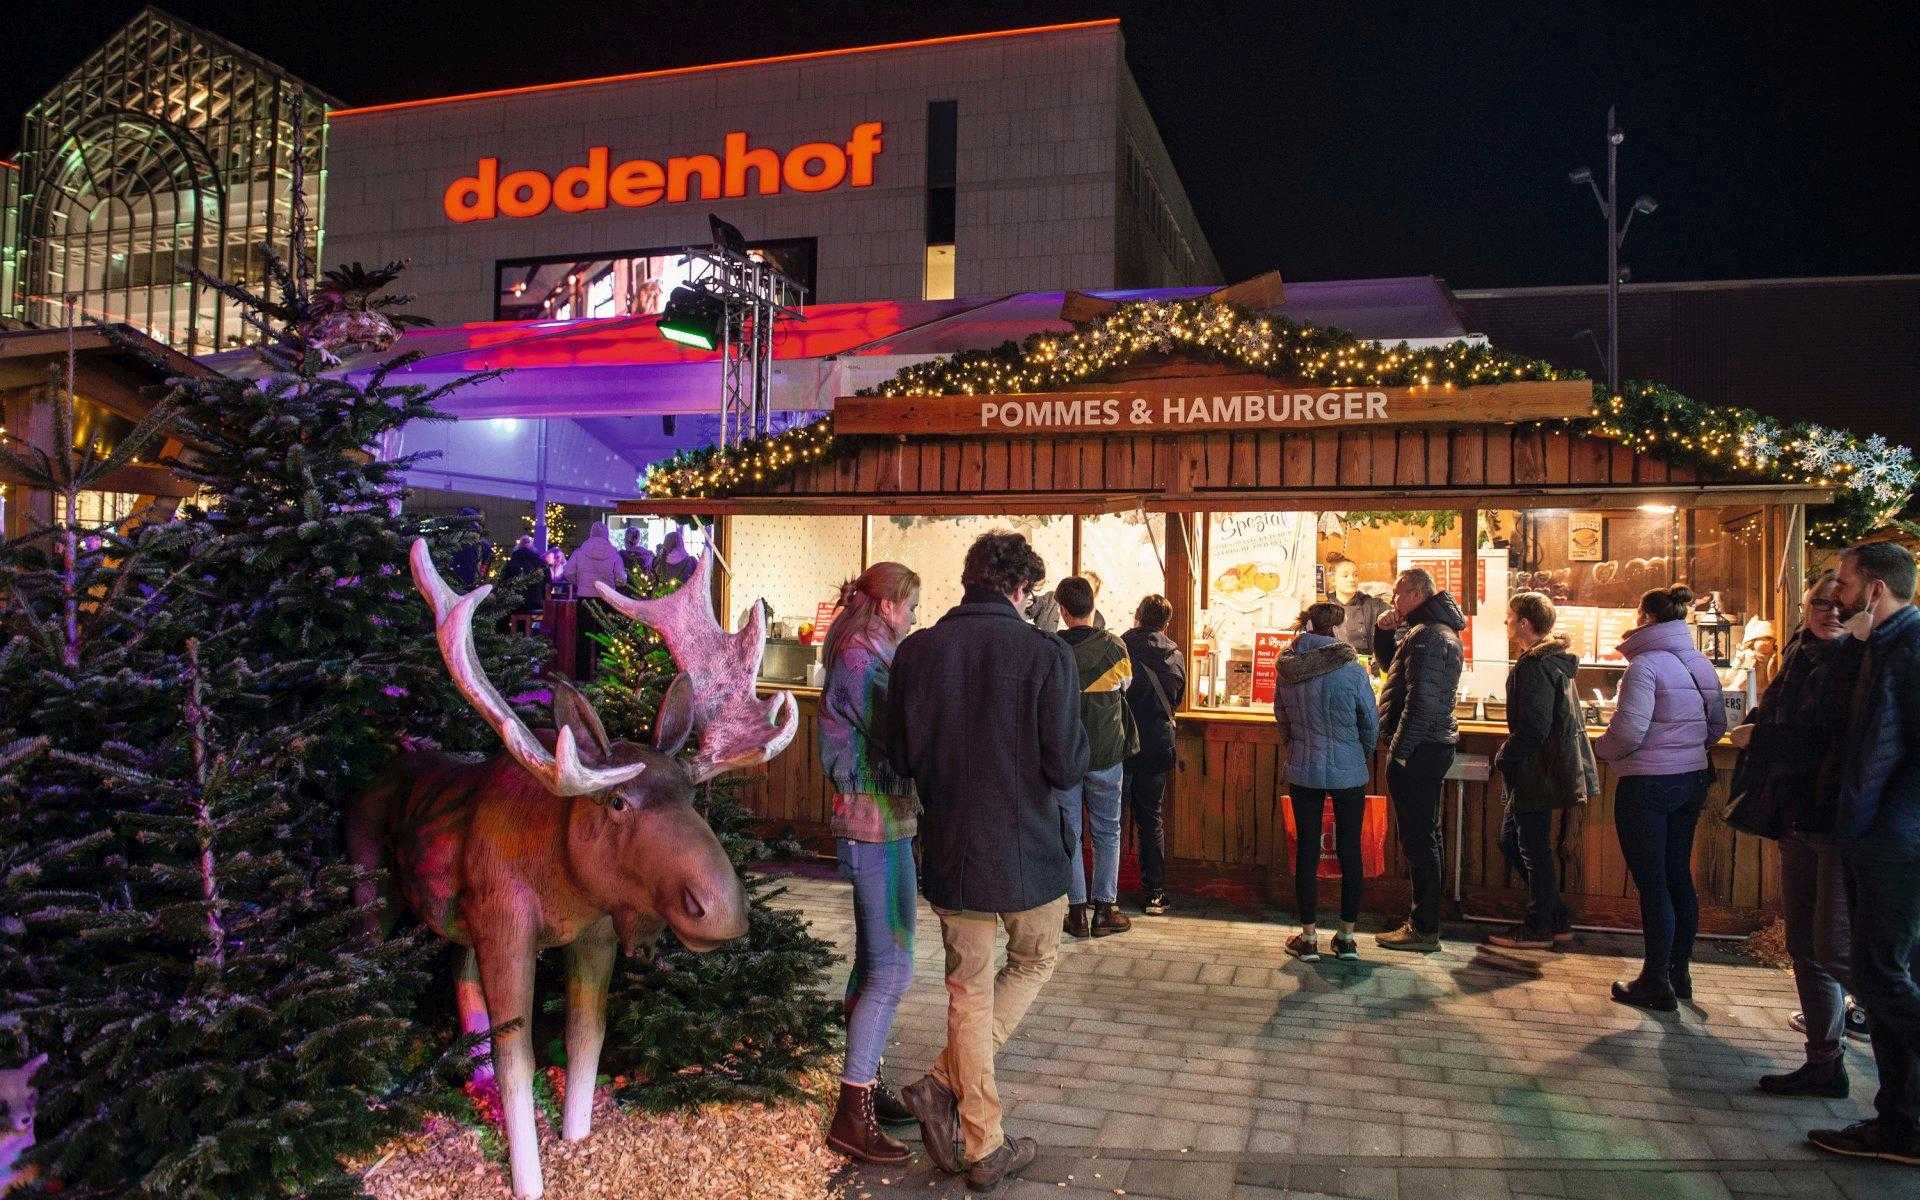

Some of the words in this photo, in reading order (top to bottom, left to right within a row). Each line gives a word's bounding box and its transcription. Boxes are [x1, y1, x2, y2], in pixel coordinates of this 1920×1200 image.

[443, 121, 884, 223] dodenhof
[981, 399, 1120, 427] POMMES
[1129, 398, 1154, 425] &
[1164, 391, 1390, 424] HAMBURGER
[1724, 698, 1741, 710] ERS
